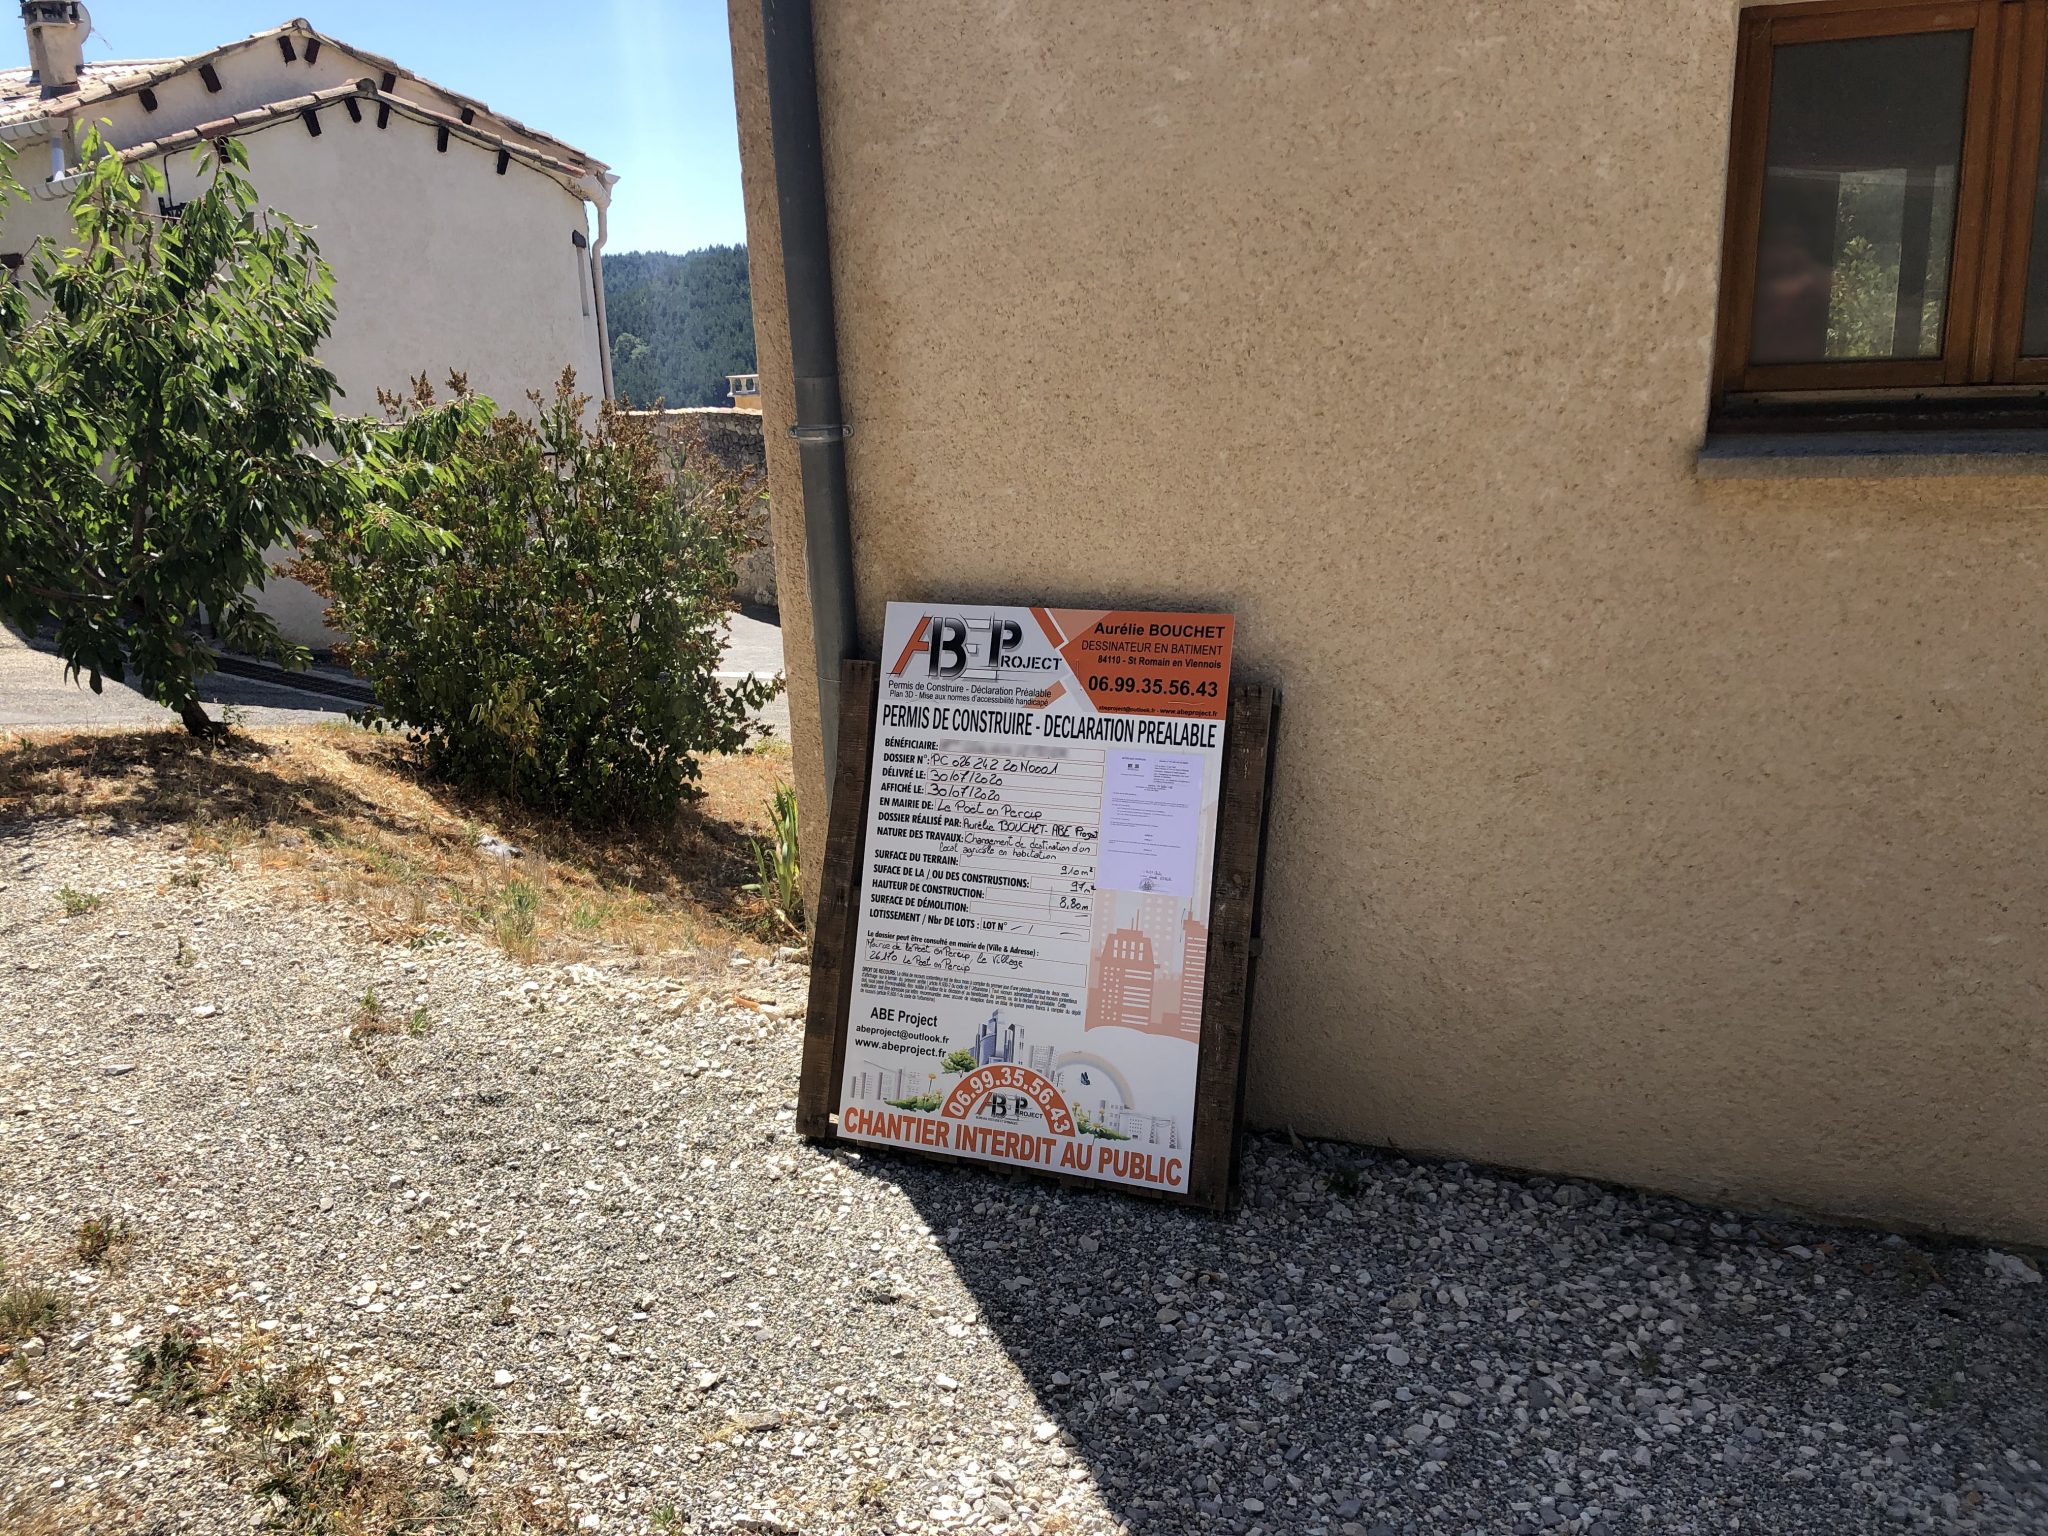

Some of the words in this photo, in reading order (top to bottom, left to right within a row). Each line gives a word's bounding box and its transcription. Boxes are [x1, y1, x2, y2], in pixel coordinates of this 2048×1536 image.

[1094, 622, 1145, 636] Aurélie
[1150, 624, 1226, 639] BOUCHET
[1081, 640, 1151, 652] DESSINATEUR
[1154, 644, 1168, 654] EN
[1171, 644, 1224, 655] BATIMENT
[1128, 656, 1136, 664] St
[1139, 656, 1170, 667] Romain
[1172, 659, 1182, 667] en
[1185, 658, 1222, 669] Viennois
[888, 680, 914, 690] Permis
[915, 682, 925, 690] de
[926, 682, 964, 693] Construire
[971, 684, 1014, 696] Déclaration
[1015, 687, 1052, 698] Préalable
[1088, 675, 1218, 697] 06.99.35.56.43
[889, 690, 904, 698] Plan
[905, 691, 914, 699] 3D
[919, 691, 933, 700] Mise
[947, 694, 970, 702] normes
[1015, 697, 1049, 707] handicapé
[882, 704, 930, 729] PERMIS
[932, 707, 950, 730] DE
[952, 708, 1034, 736] CONSTRUIRE
[1043, 714, 1135, 743] DECLARATION
[1137, 720, 1217, 748] PREALABLE
[884, 736, 939, 751] BÉNÉFICIAIRE:
[883, 752, 915, 764] DOSSIER
[931, 753, 949, 766] PC
[882, 766, 914, 779] DÉLIVRÉ
[880, 780, 912, 794] AFFICHÉ
[879, 797, 890, 806] EN
[891, 798, 920, 809] MAIRIE
[878, 811, 910, 823] DOSSIER
[911, 812, 942, 826] RÉALISÉ
[876, 826, 907, 838] NATURE
[909, 829, 923, 839] DES
[925, 830, 964, 843] TRAVAUX:
[874, 849, 907, 860] SURFACE
[909, 852, 921, 862] DU
[922, 853, 959, 866] TERRAIN:
[873, 864, 901, 875] SUFACE
[903, 866, 913, 877] DE
[914, 867, 925, 878] LA
[932, 870, 944, 879] OU
[945, 870, 960, 881] DES
[872, 879, 908, 891] HAUTEUR
[909, 882, 920, 892] DE
[921, 883, 985, 899] CONSTRUCTION:
[870, 893, 903, 905] SURFACE
[905, 897, 915, 907] DE
[917, 897, 969, 912] DÉMOLITION:
[869, 908, 920, 922] LOTISSEMENT
[927, 914, 942, 925] Nbr
[944, 917, 954, 926] DE
[956, 918, 975, 929] LOTS
[982, 922, 996, 931] LOT
[875, 930, 895, 939] dossier
[896, 934, 909, 942] peut
[910, 935, 922, 943] être
[923, 937, 947, 946] consulté
[958, 941, 977, 949] mairie
[870, 1006, 895, 1021] ABE
[898, 1010, 938, 1027] Project
[855, 1024, 950, 1044] abeproject@outlook.fr
[854, 1038, 947, 1058] www.abeproject.fr
[948, 1067, 1071, 1134] 06.99.35.56.43
[844, 1106, 950, 1148] CHANTIER
[955, 1124, 1057, 1165] INTERDIT
[1060, 1141, 1093, 1171] AU
[1098, 1146, 1183, 1187] PUBLIC
